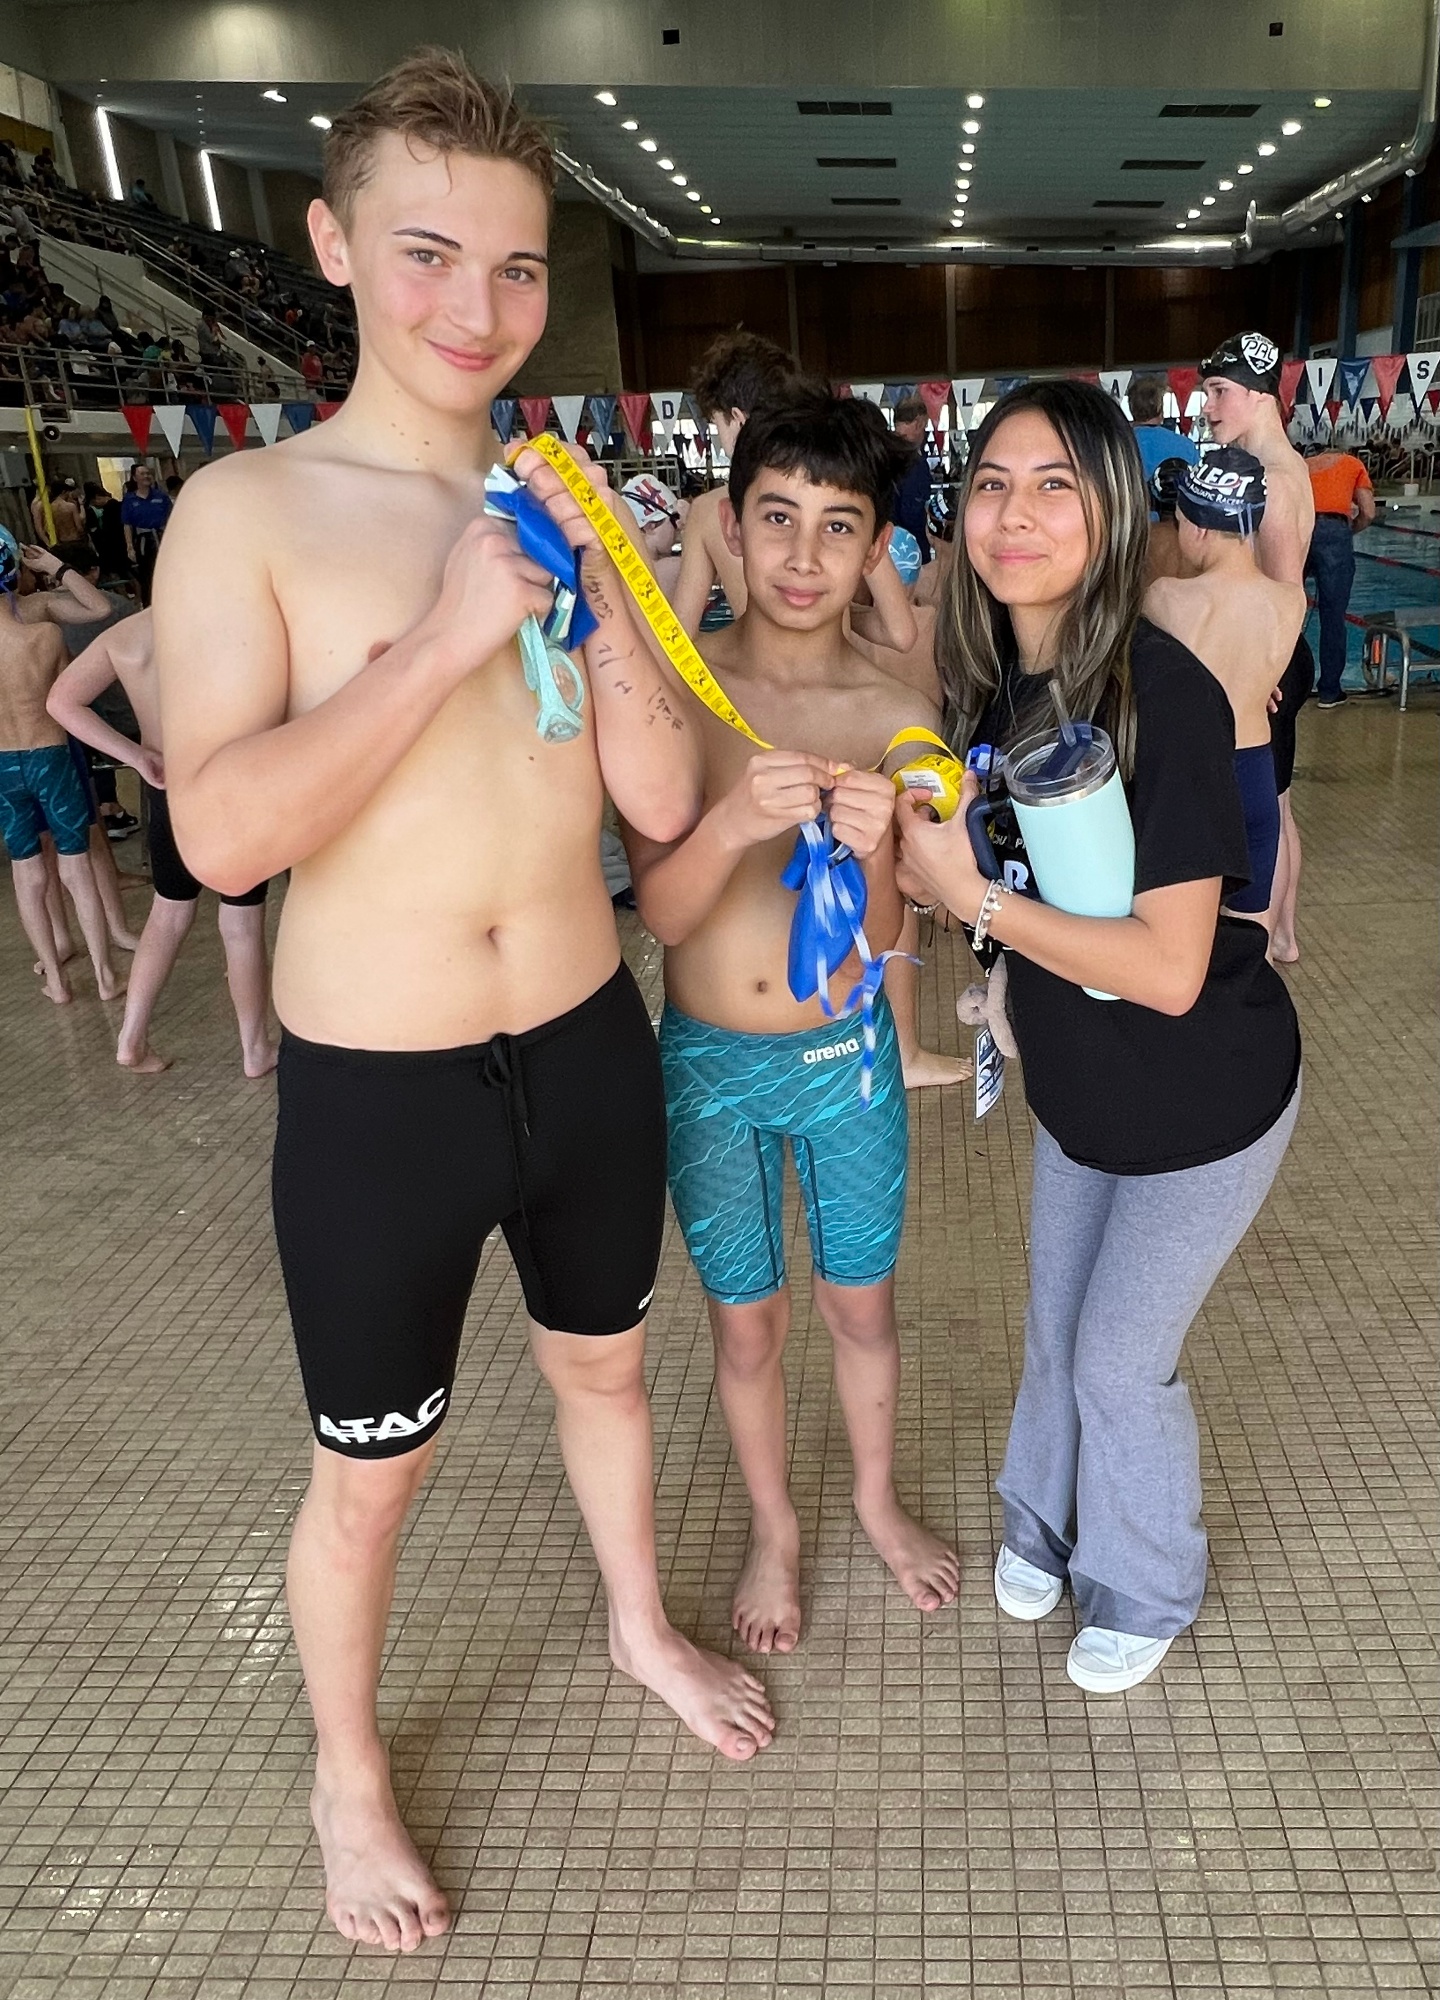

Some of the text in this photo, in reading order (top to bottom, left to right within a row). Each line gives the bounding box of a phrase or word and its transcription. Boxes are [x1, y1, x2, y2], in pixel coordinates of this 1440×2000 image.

[661, 400, 675, 420] D
[962, 387, 973, 407] L
[1110, 378, 1121, 399] A
[1416, 360, 1430, 380] S
[803, 1038, 860, 1065] arena
